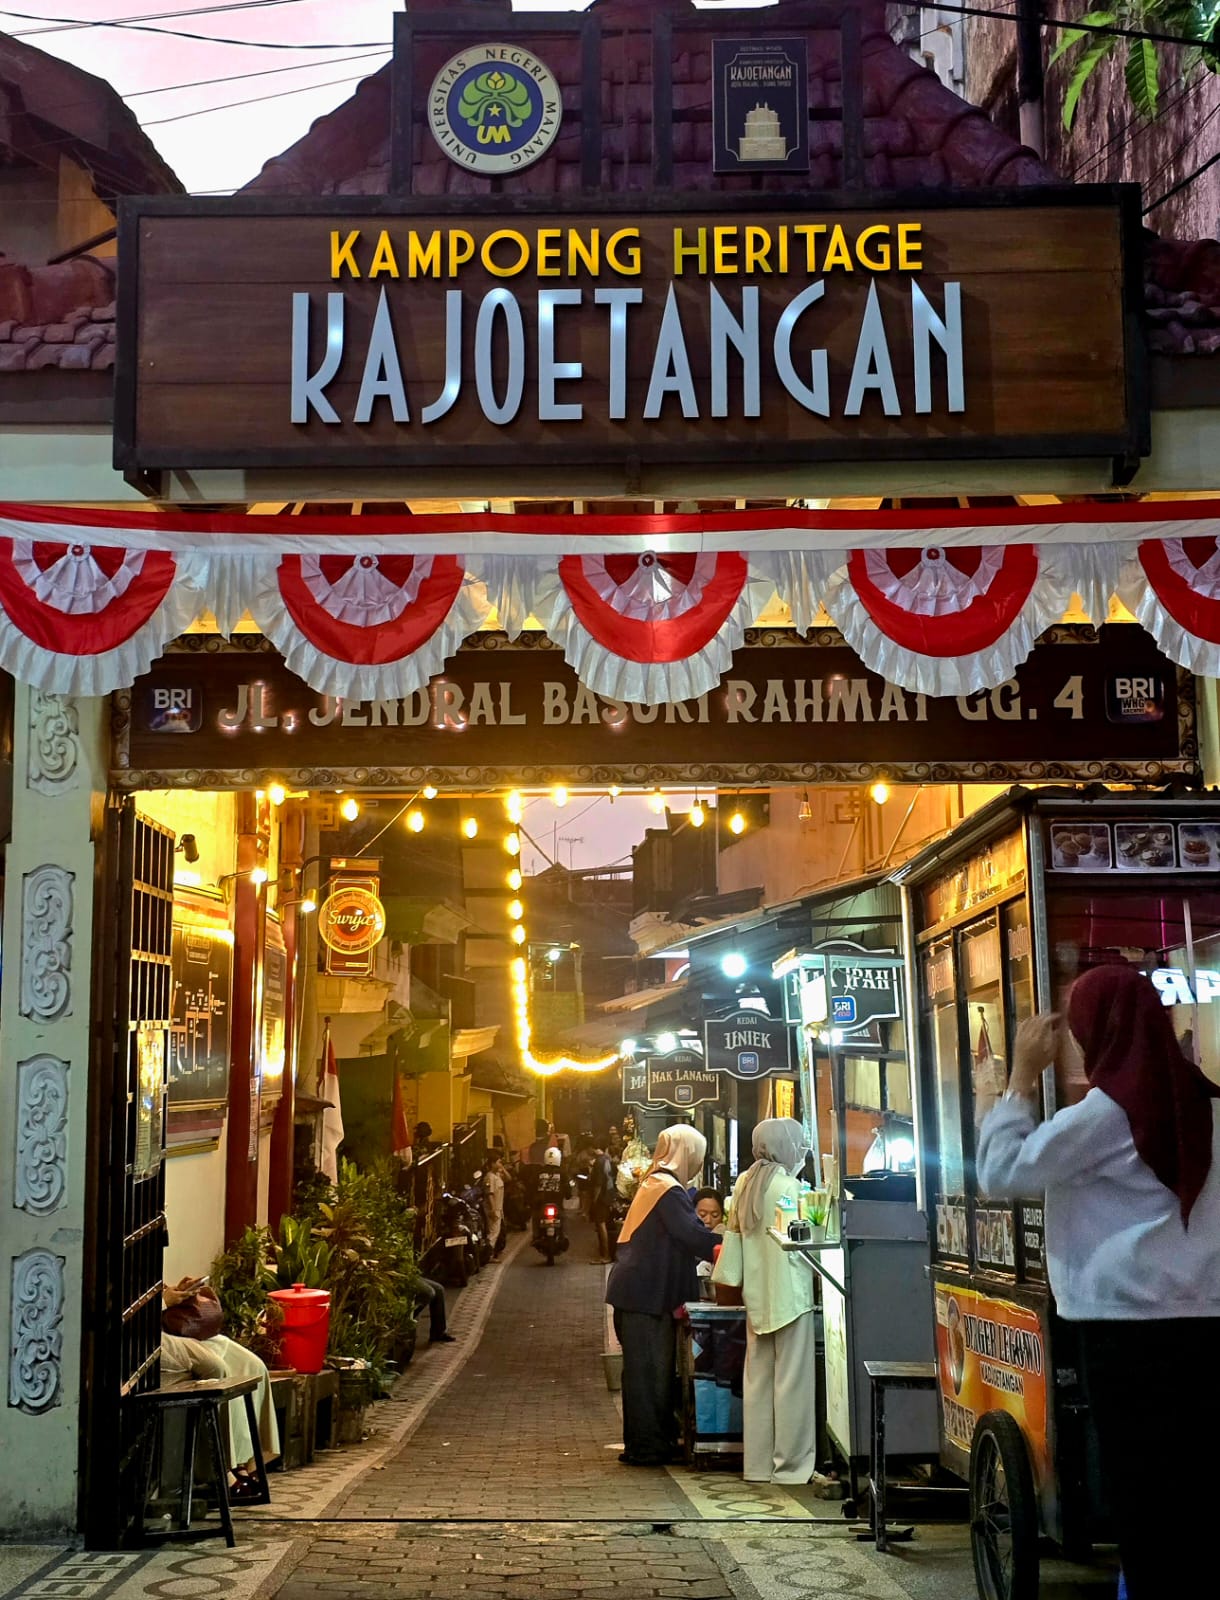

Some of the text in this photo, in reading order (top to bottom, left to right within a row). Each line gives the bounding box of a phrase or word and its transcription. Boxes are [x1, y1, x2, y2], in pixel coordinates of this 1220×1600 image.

[730, 65, 792, 81] KAJOETANGAN
[434, 48, 556, 165] UNIVERSITAS NEGERI MALANG
[477, 124, 512, 144] UM
[330, 223, 923, 278] KAMPOENG HERITAGE
[290, 277, 965, 425] KAJOETANGAN
[154, 688, 192, 708] BRI
[1115, 678, 1154, 698] BRI
[217, 682, 293, 728] JL.
[308, 682, 527, 727] JENDRAL
[956, 678, 1038, 721] GG.
[1053, 675, 1084, 719] 4
[724, 1031, 771, 1050] UNIEK
[676, 1069, 715, 1082] LANANG
